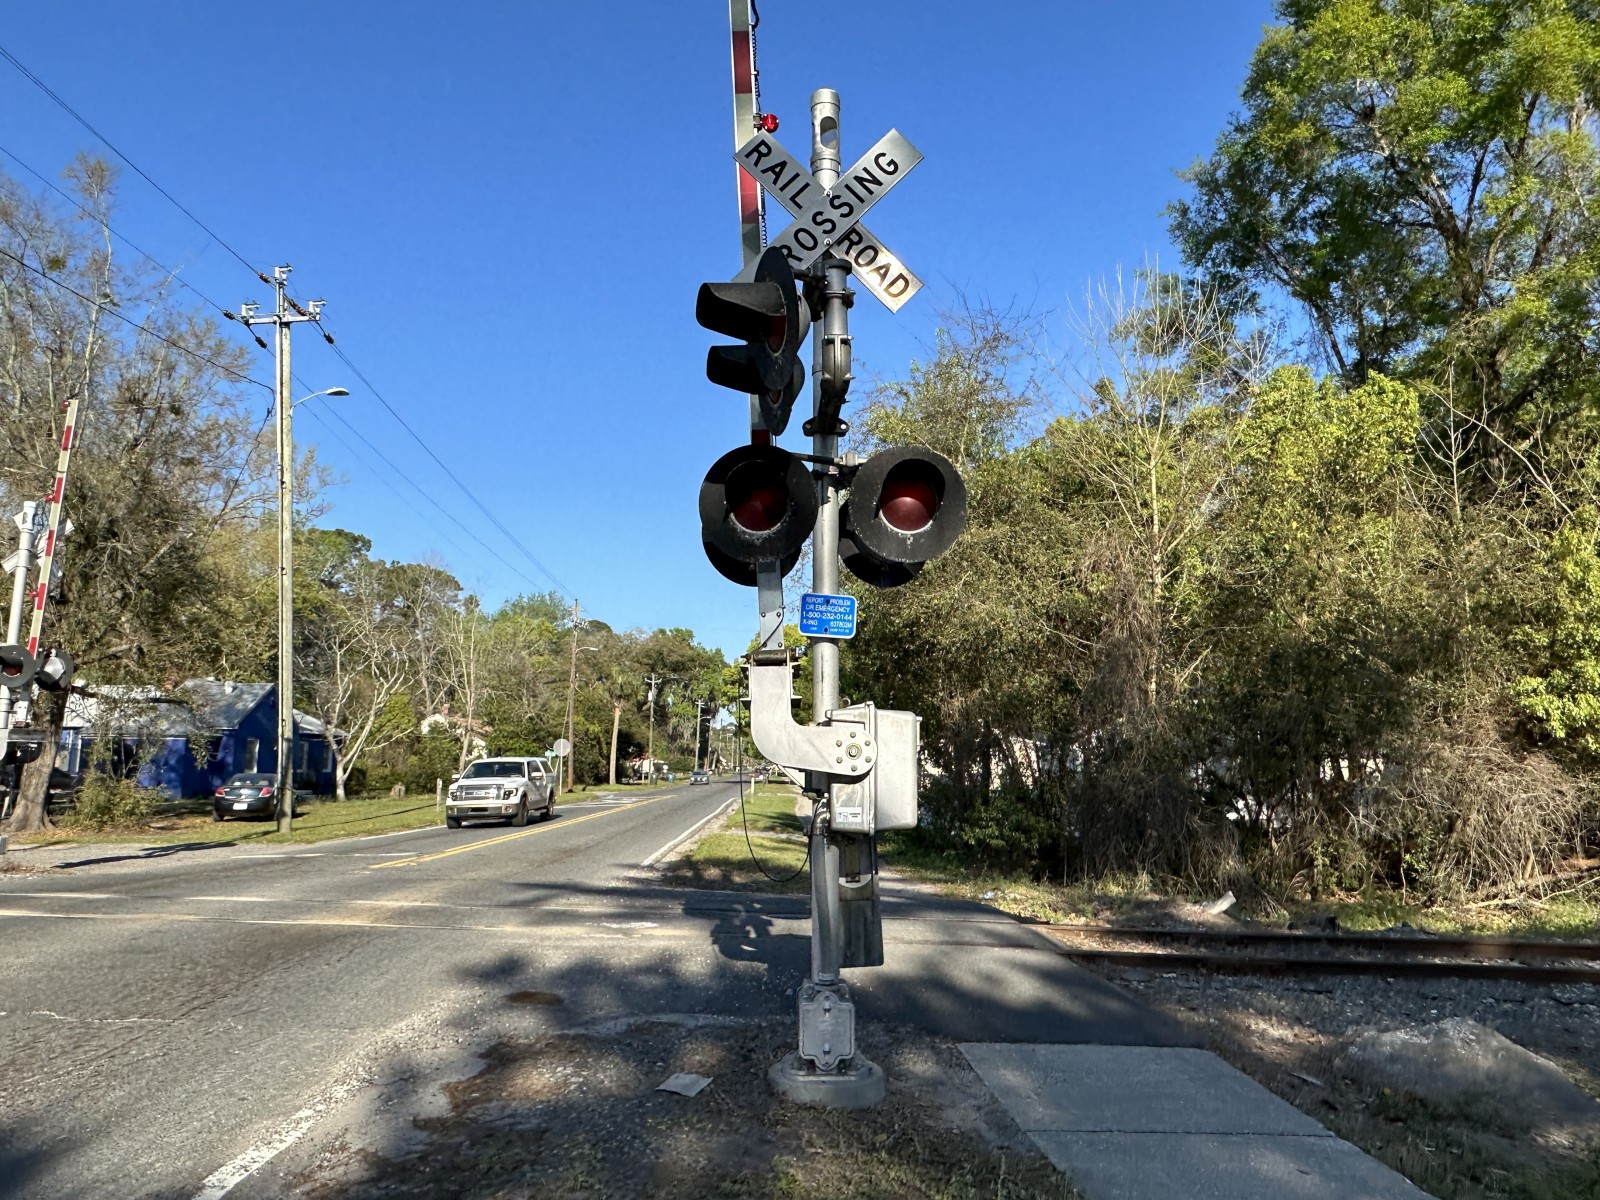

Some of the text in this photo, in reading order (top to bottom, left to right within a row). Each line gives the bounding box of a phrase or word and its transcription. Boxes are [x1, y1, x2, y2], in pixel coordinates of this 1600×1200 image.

[744, 139, 811, 211] RAIL
[779, 152, 899, 267] ROSSING
[836, 225, 911, 299] ROAD
[816, 604, 850, 613] EMERGENCY
